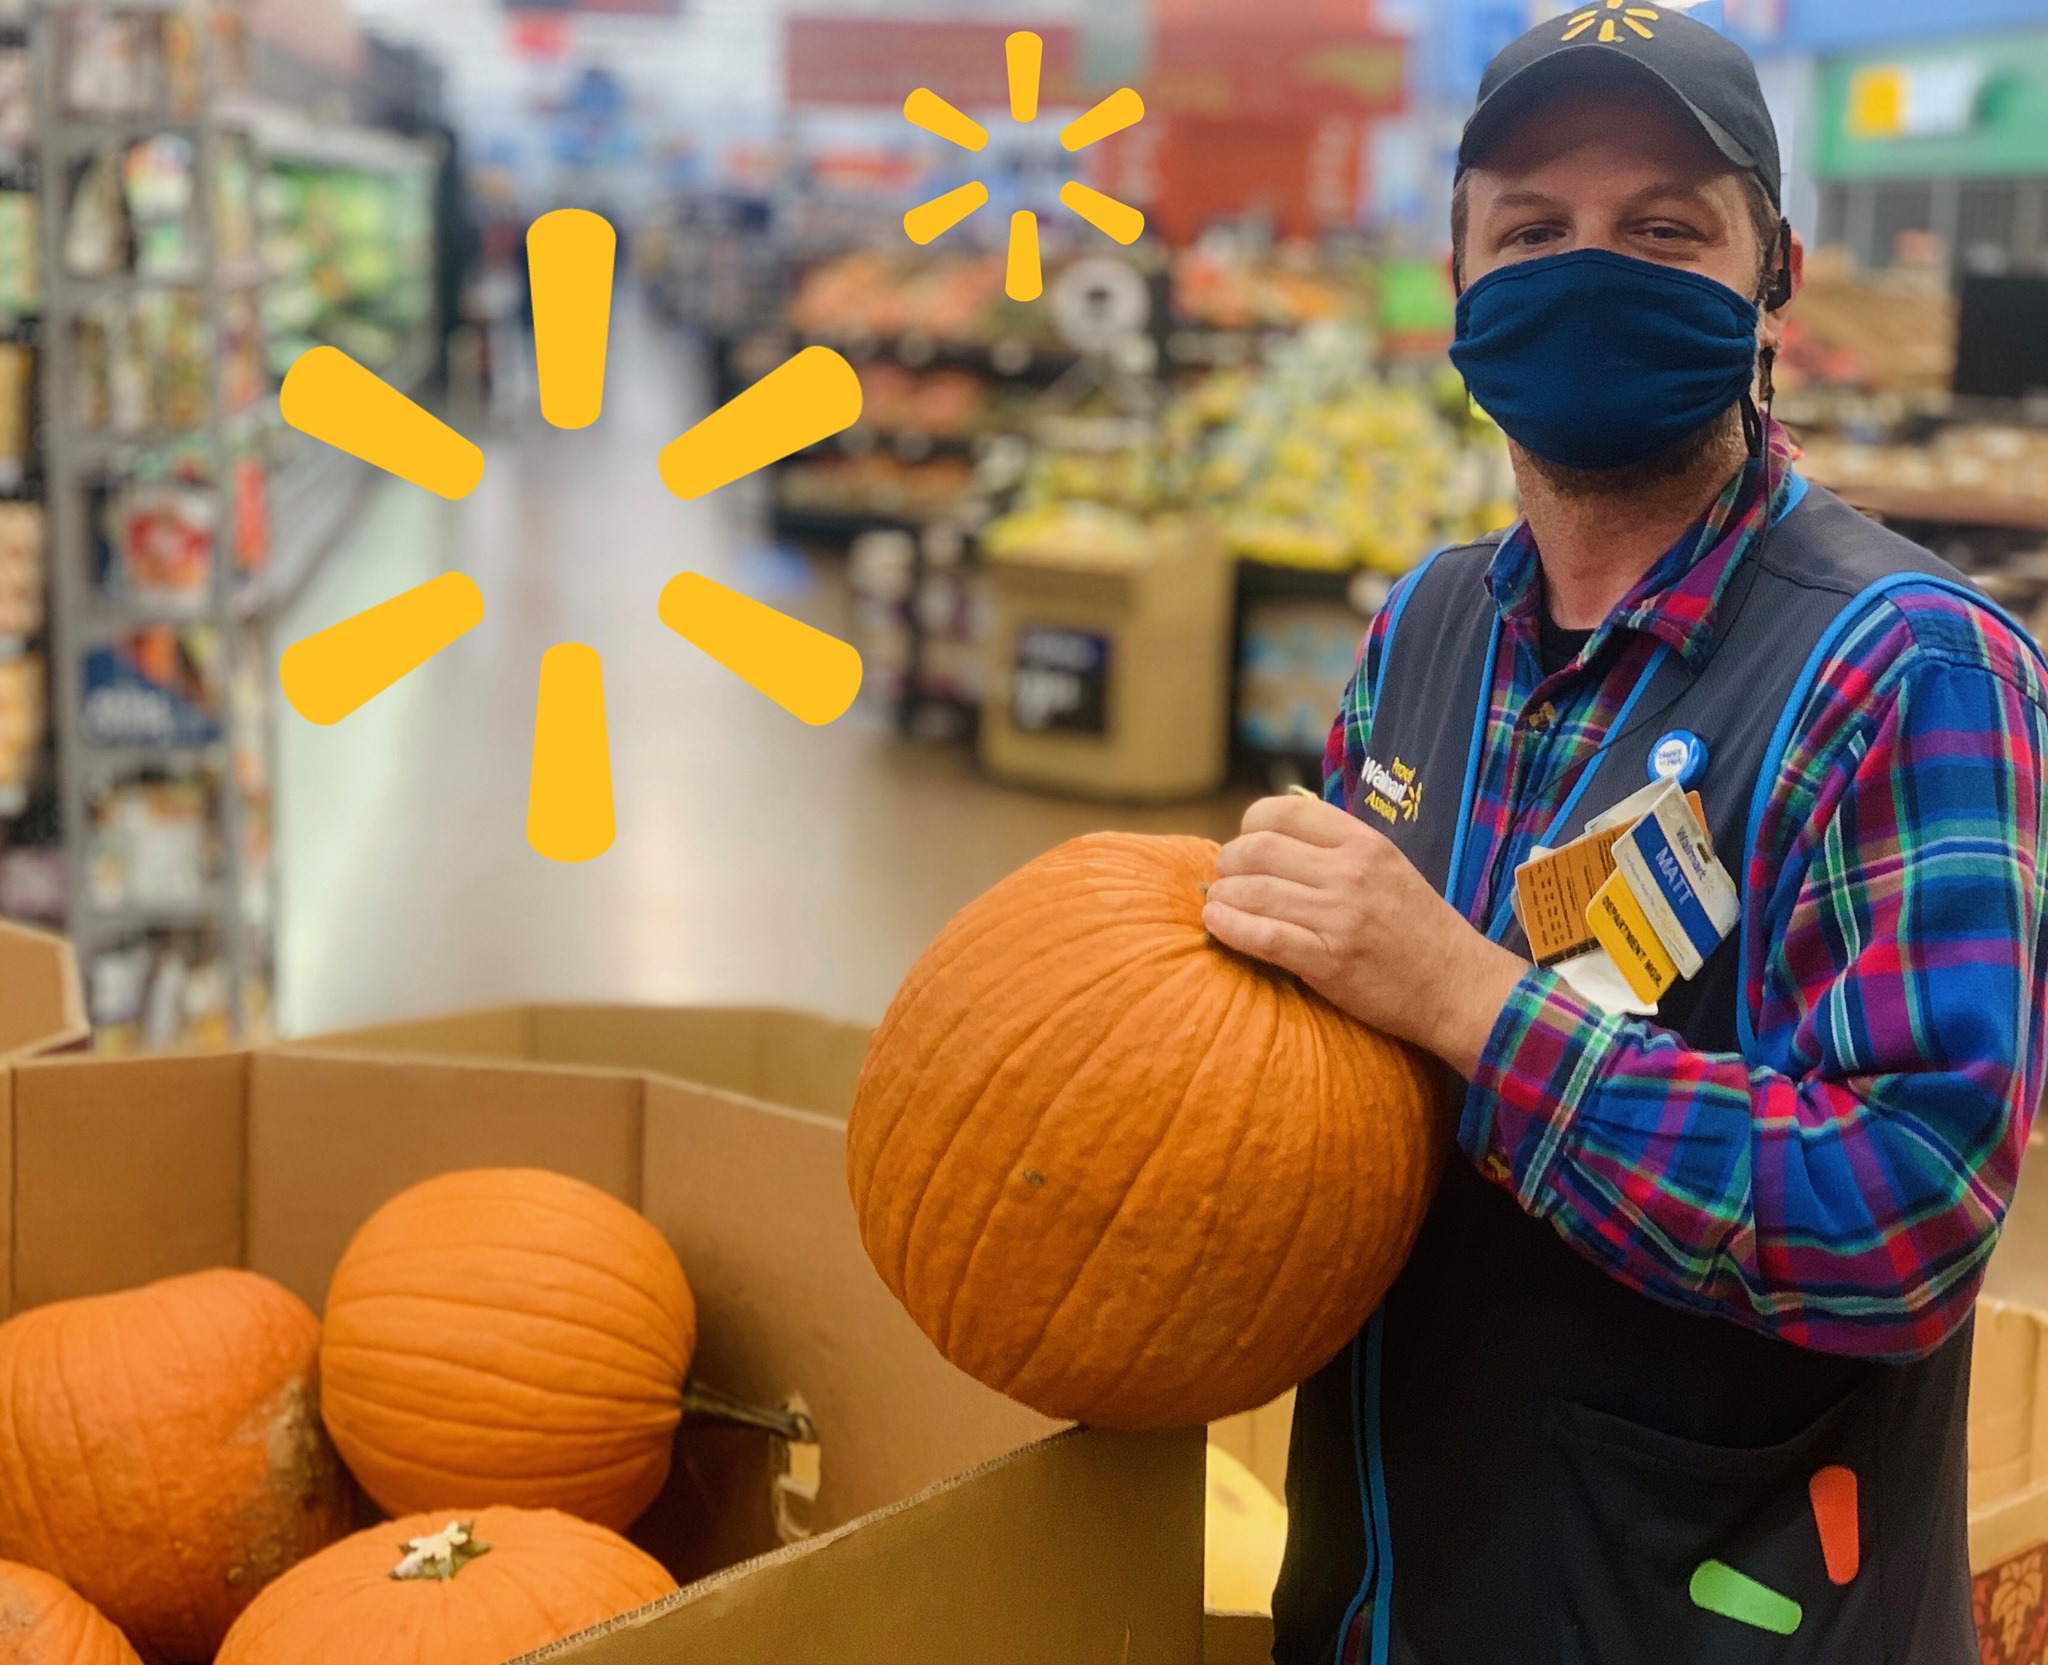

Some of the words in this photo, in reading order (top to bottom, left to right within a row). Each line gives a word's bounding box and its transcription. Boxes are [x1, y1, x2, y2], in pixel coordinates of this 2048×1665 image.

[1361, 756, 1407, 804] Walmart
[1655, 846, 1694, 905] MATT
[1676, 825, 1706, 881] Walmart
[1602, 895, 1647, 962] DEPARTMENT
